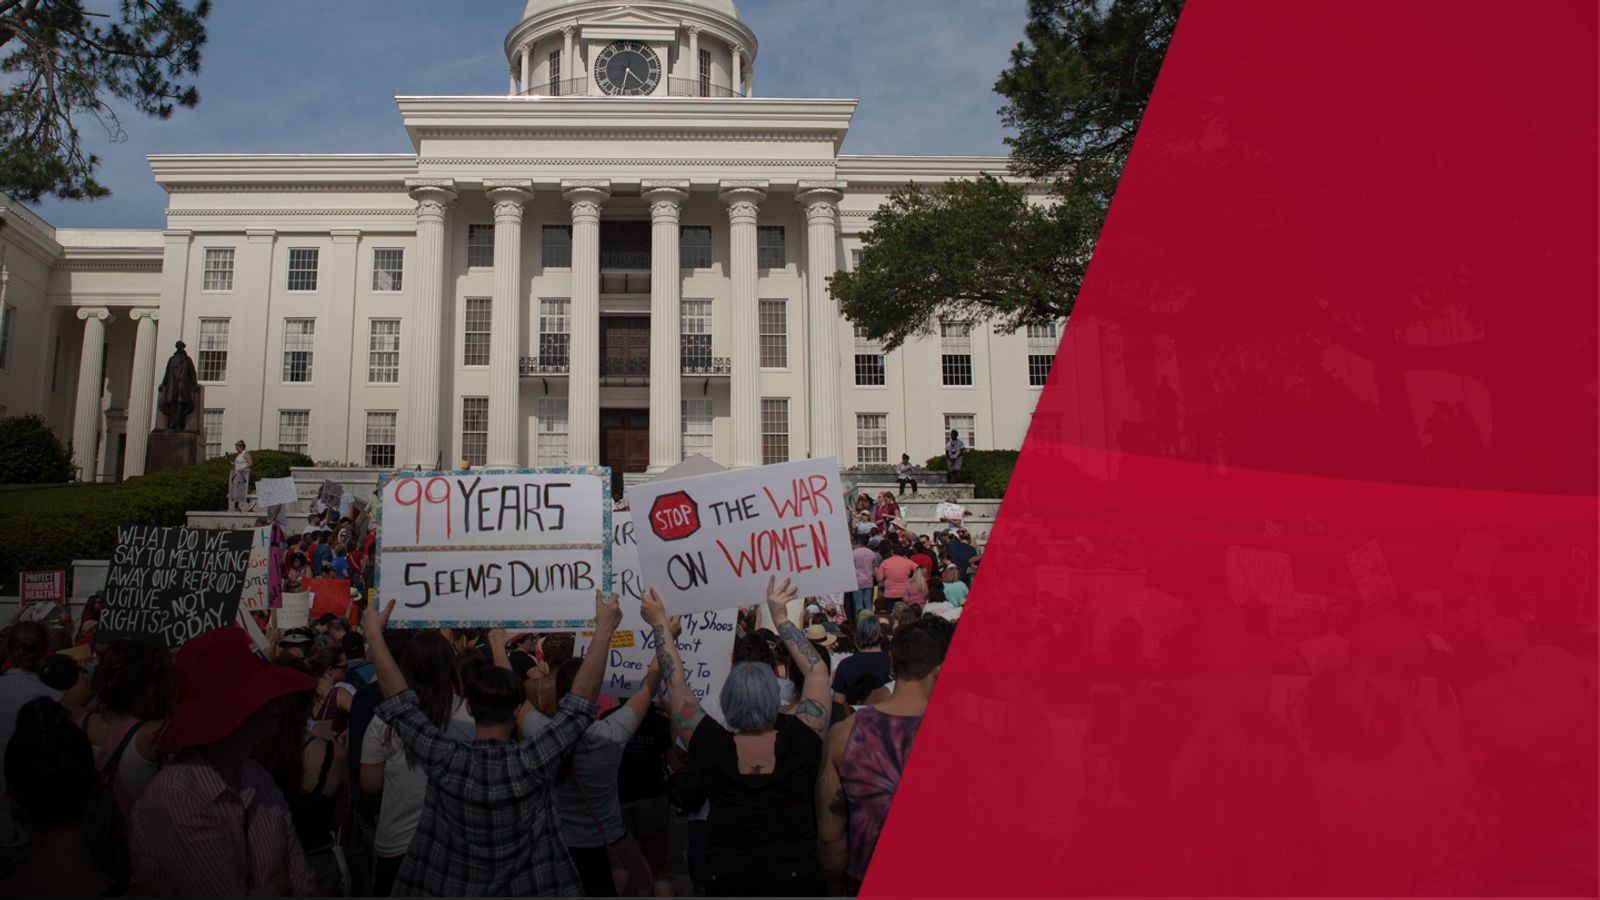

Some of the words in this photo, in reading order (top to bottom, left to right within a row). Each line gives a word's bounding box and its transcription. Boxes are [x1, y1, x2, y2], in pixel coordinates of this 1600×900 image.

[395, 476, 451, 545] 99
[457, 476, 571, 533] YEARS
[655, 505, 693, 531] STOP
[709, 494, 760, 526] THE
[762, 474, 833, 518] WAR
[117, 525, 173, 548] WHAT
[177, 526, 199, 550] DO
[204, 530, 232, 551] WE
[114, 544, 146, 566] SAY
[147, 546, 166, 567] TO
[168, 548, 199, 569] MEN
[201, 549, 250, 572] TAKING
[667, 551, 709, 591] ON
[716, 520, 830, 577] WOMEN
[25, 573, 54, 582] PROTECT
[108, 566, 150, 589] AWAY
[152, 568, 177, 590] OUR
[182, 570, 243, 594] REPROD-
[404, 562, 502, 608] SEEMS
[508, 560, 595, 597] DUMB
[106, 587, 162, 610] UCTIVE
[171, 588, 210, 617] NOT
[98, 608, 169, 633] RIGHTS?
[158, 602, 228, 647] TODAY.
[679, 613, 698, 635] My
[700, 610, 733, 632] Shoes
[611, 650, 643, 669] Dare
[697, 662, 711, 678] To
[611, 673, 631, 690] Me
